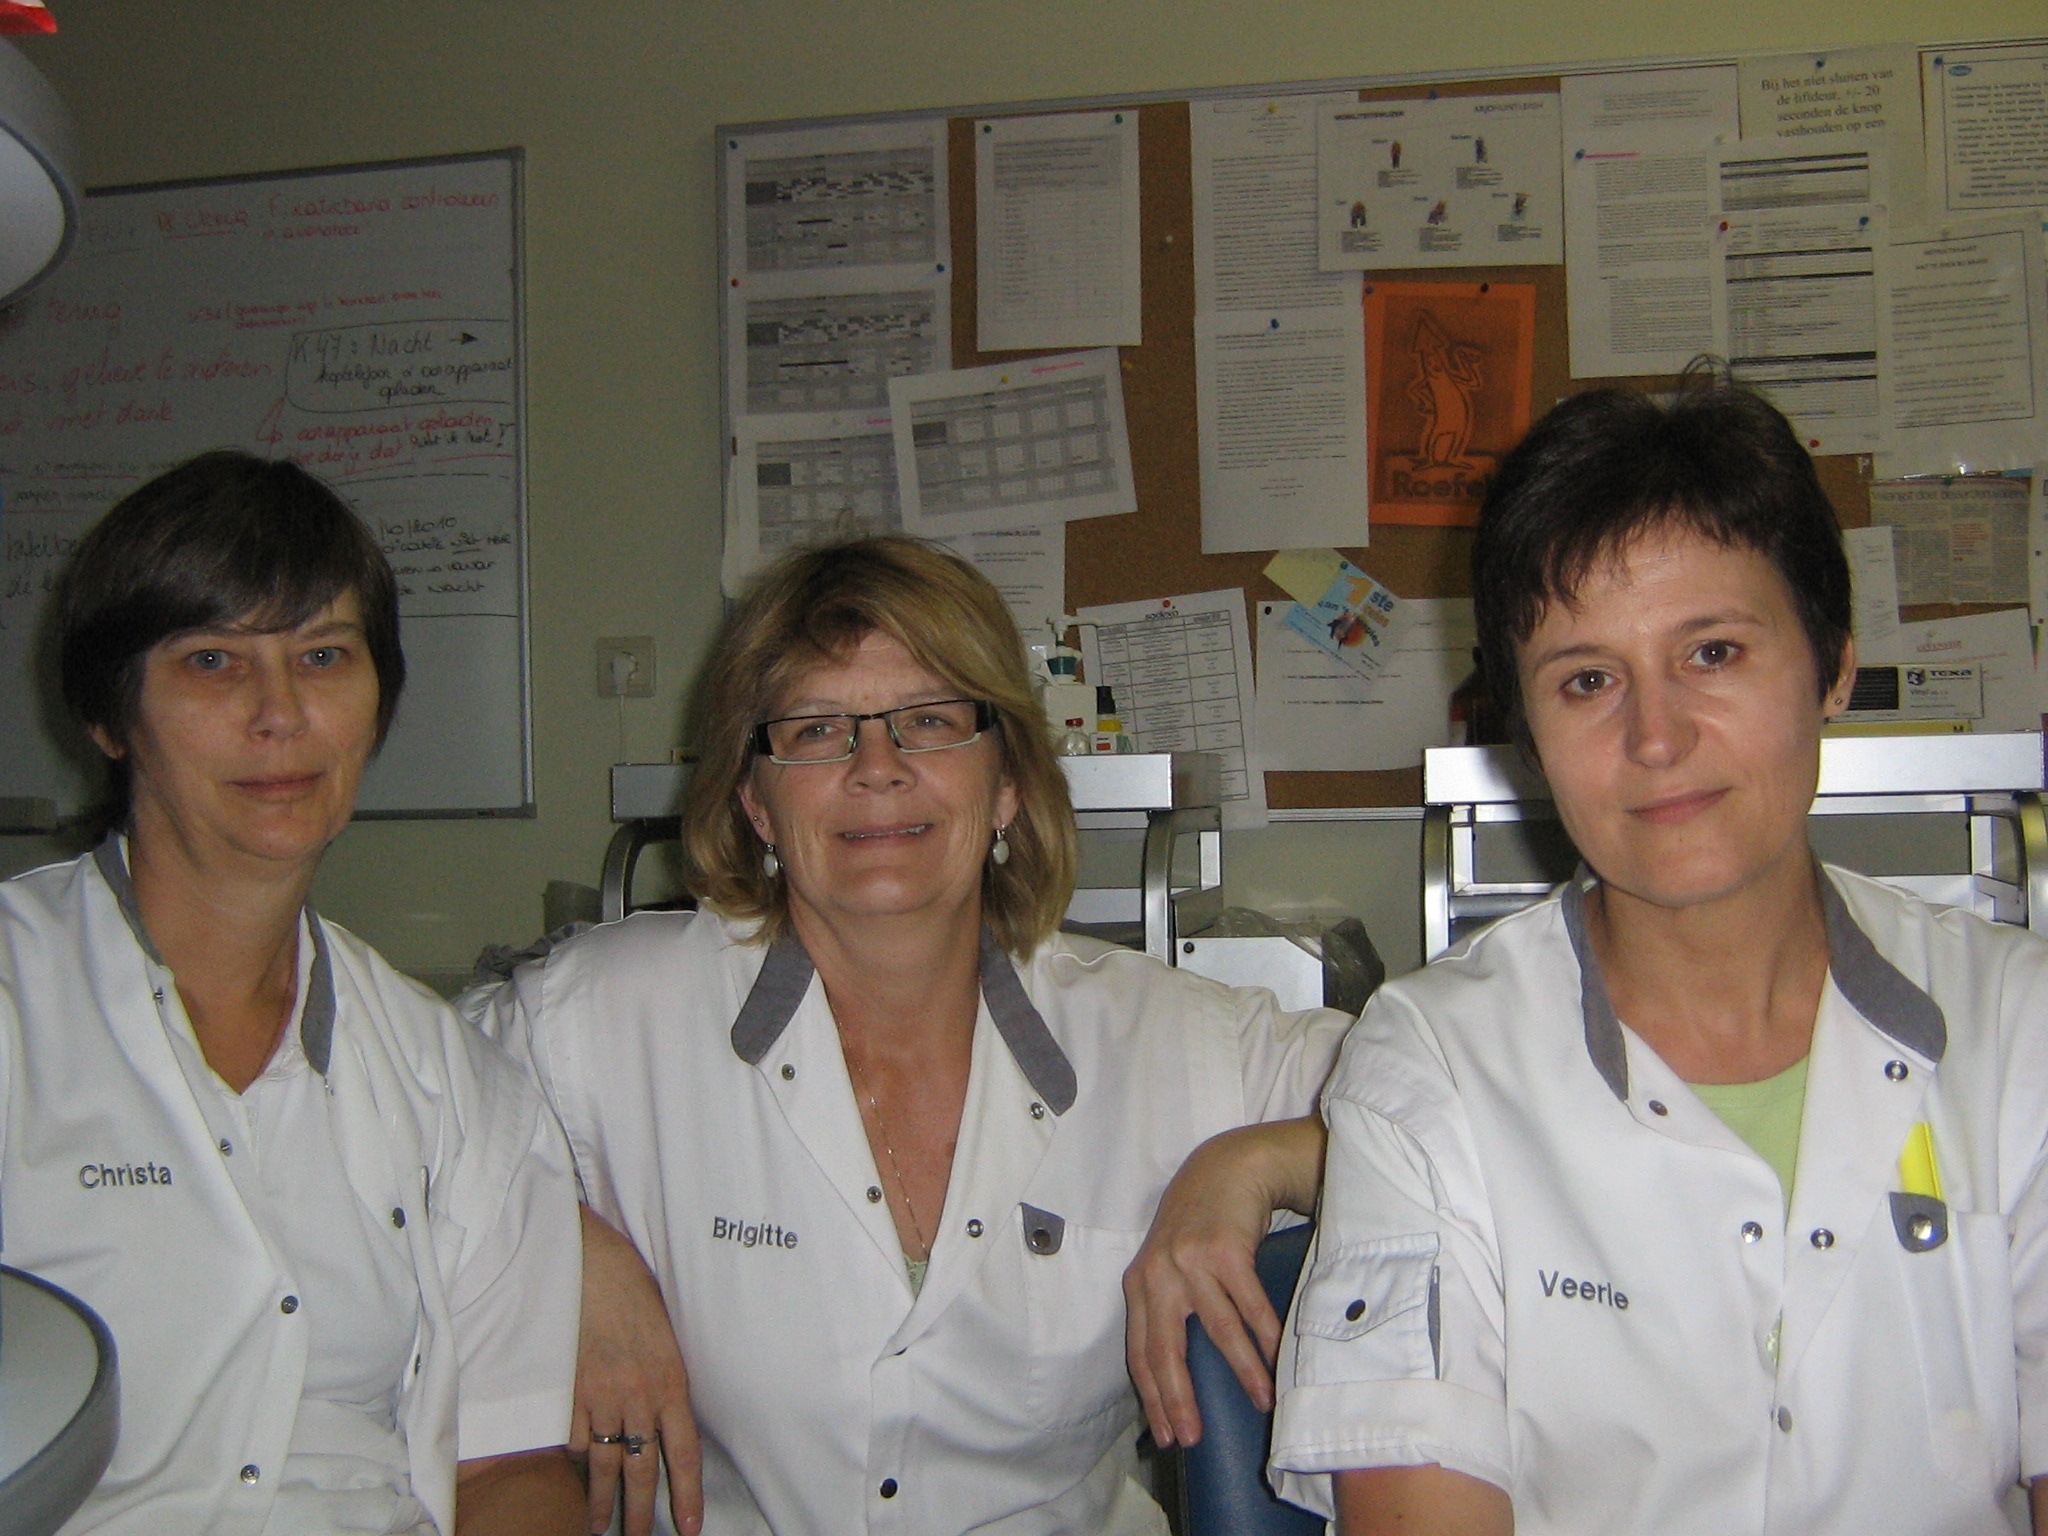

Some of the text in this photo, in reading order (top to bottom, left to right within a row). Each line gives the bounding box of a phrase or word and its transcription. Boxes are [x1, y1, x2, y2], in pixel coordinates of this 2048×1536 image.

[1761, 69, 1894, 92] Bij het niet sluiten van
[1776, 93, 1791, 106] de
[1865, 85, 1881, 97] 20
[1777, 102, 1883, 122] seconden de knop
[1776, 118, 1886, 138] vasthouden op een
[79, 1161, 173, 1189] Christa
[712, 1216, 799, 1249] Brigitte
[1538, 1269, 1630, 1310] Veerle
